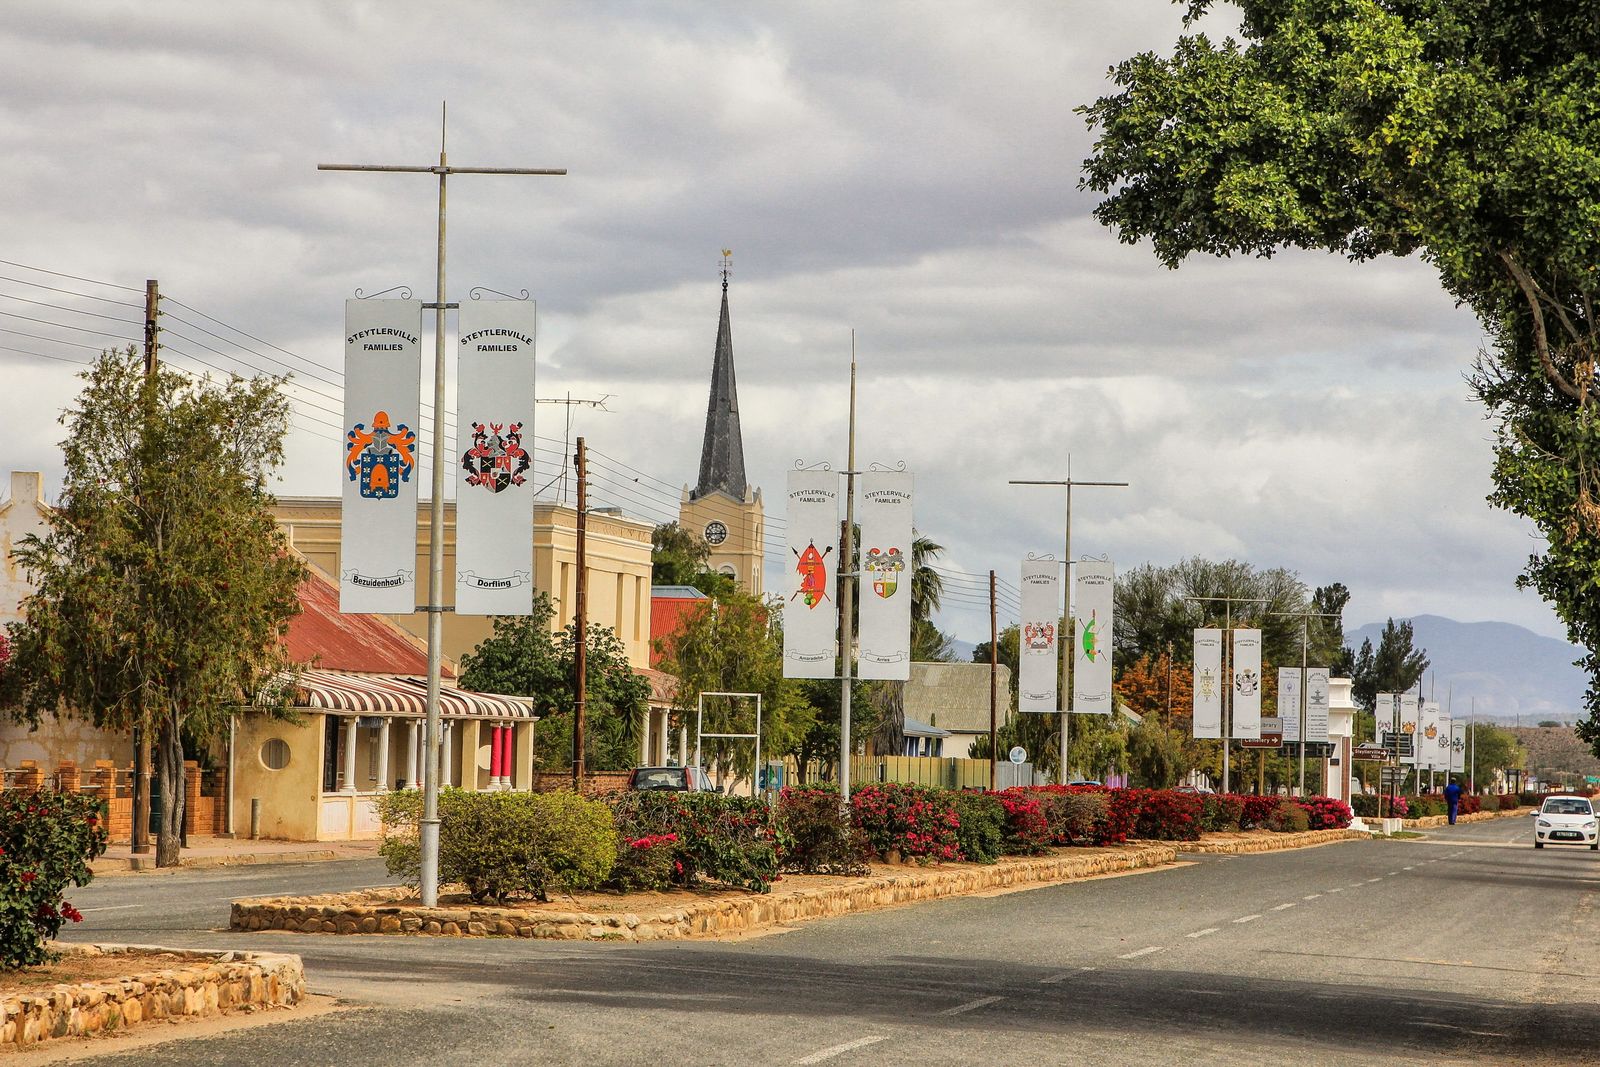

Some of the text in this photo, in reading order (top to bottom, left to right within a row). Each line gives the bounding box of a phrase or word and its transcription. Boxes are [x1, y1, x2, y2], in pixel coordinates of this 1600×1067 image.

[347, 327, 419, 345] STEYTLERVILLE
[460, 328, 533, 346] STEYTLERVILLE
[363, 343, 404, 351] FAMILIES
[477, 344, 518, 352] FAMILIES
[789, 489, 836, 498] STEYTLERVILLE
[864, 490, 912, 499] STEYTLERVILLE
[353, 576, 402, 586] Bezuidenhout
[477, 579, 512, 588] Dorfling
